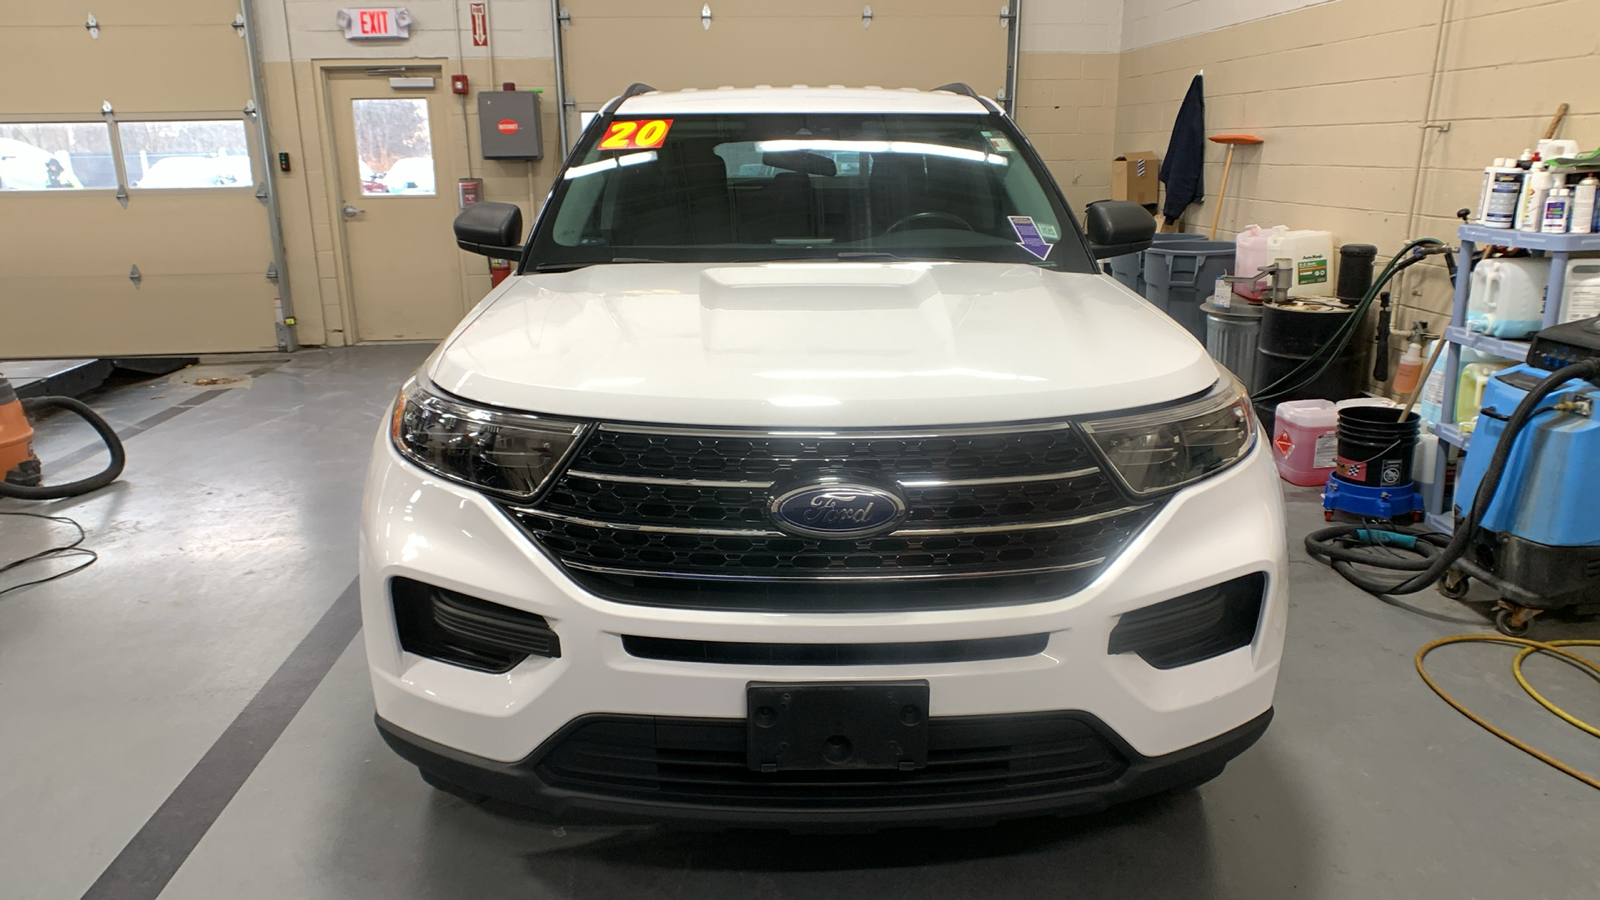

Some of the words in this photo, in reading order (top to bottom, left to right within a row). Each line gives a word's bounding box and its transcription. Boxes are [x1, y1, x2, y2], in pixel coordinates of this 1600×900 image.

[360, 11, 388, 34] EXIT
[601, 120, 668, 147] 20
[804, 493, 874, 522] Ford
